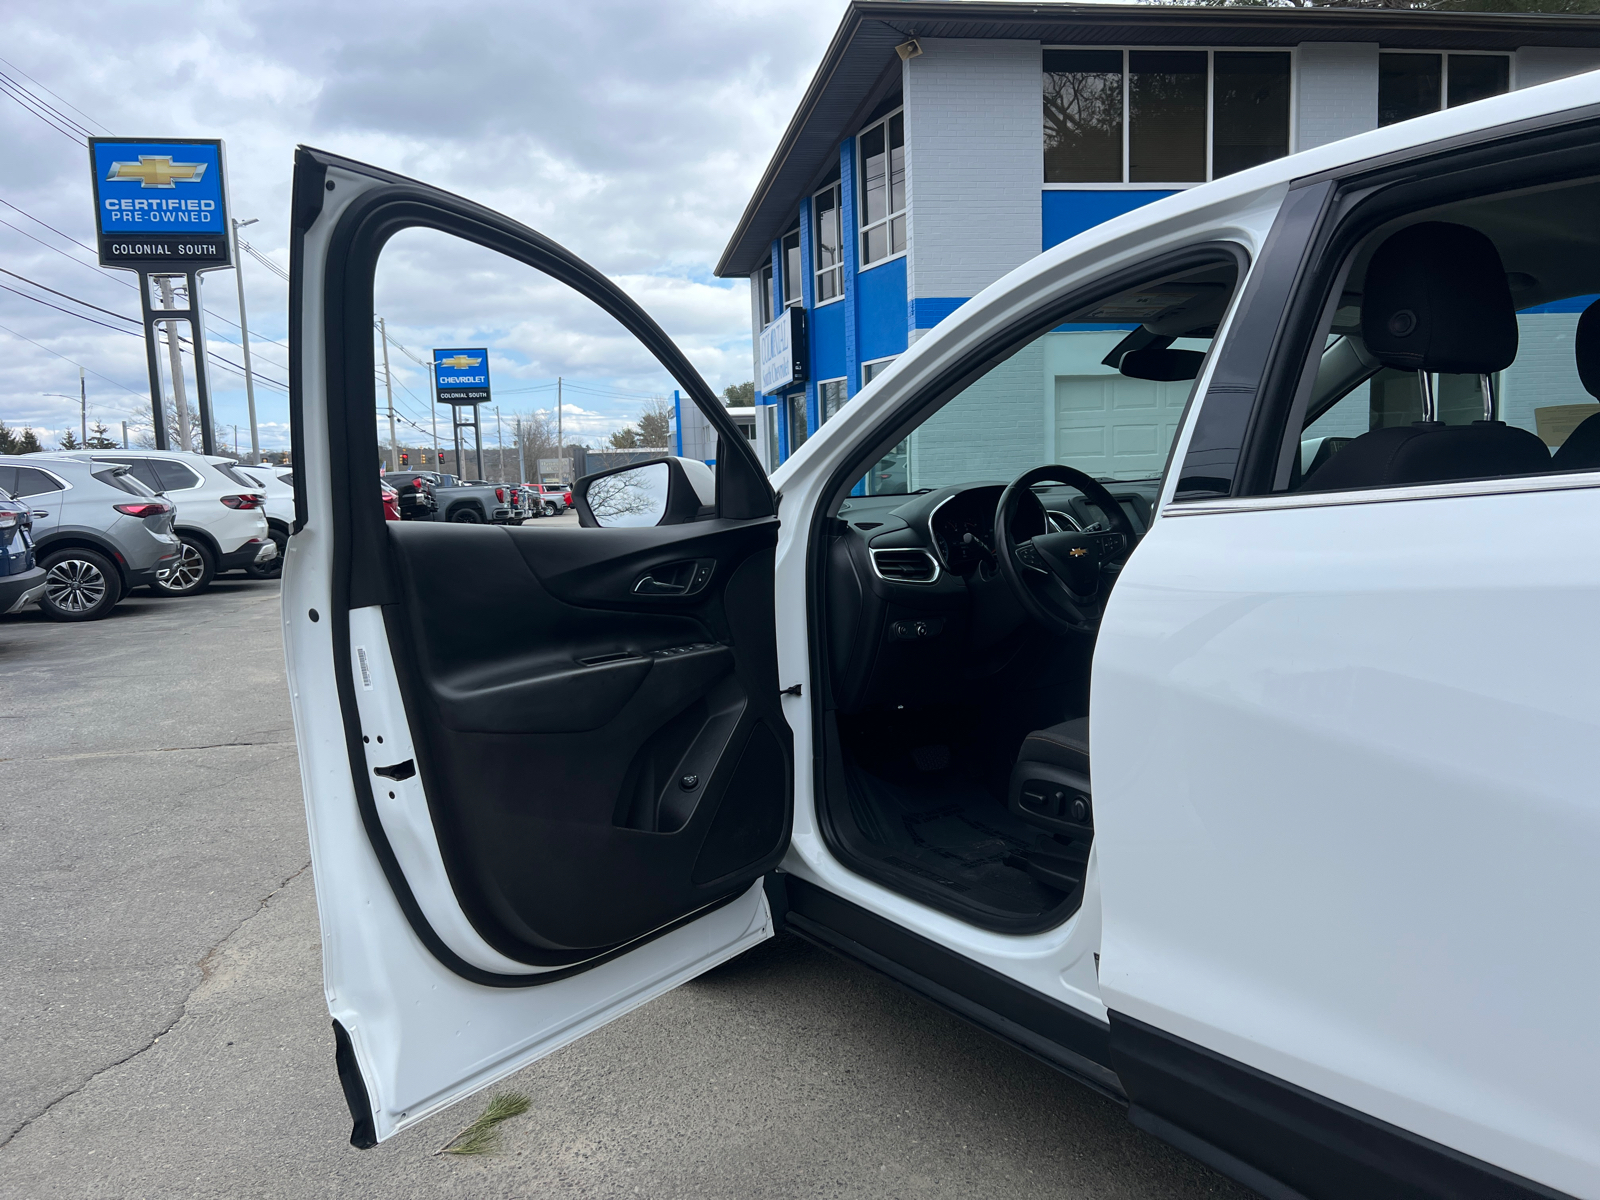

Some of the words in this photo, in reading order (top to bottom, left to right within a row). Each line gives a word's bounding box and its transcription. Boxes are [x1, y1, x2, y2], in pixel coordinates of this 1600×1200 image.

[105, 199, 215, 211] CERTIFIED
[111, 211, 211, 222] PRE-OWNED
[112, 244, 171, 255] COLONIAL
[178, 244, 216, 255] SOUTH
